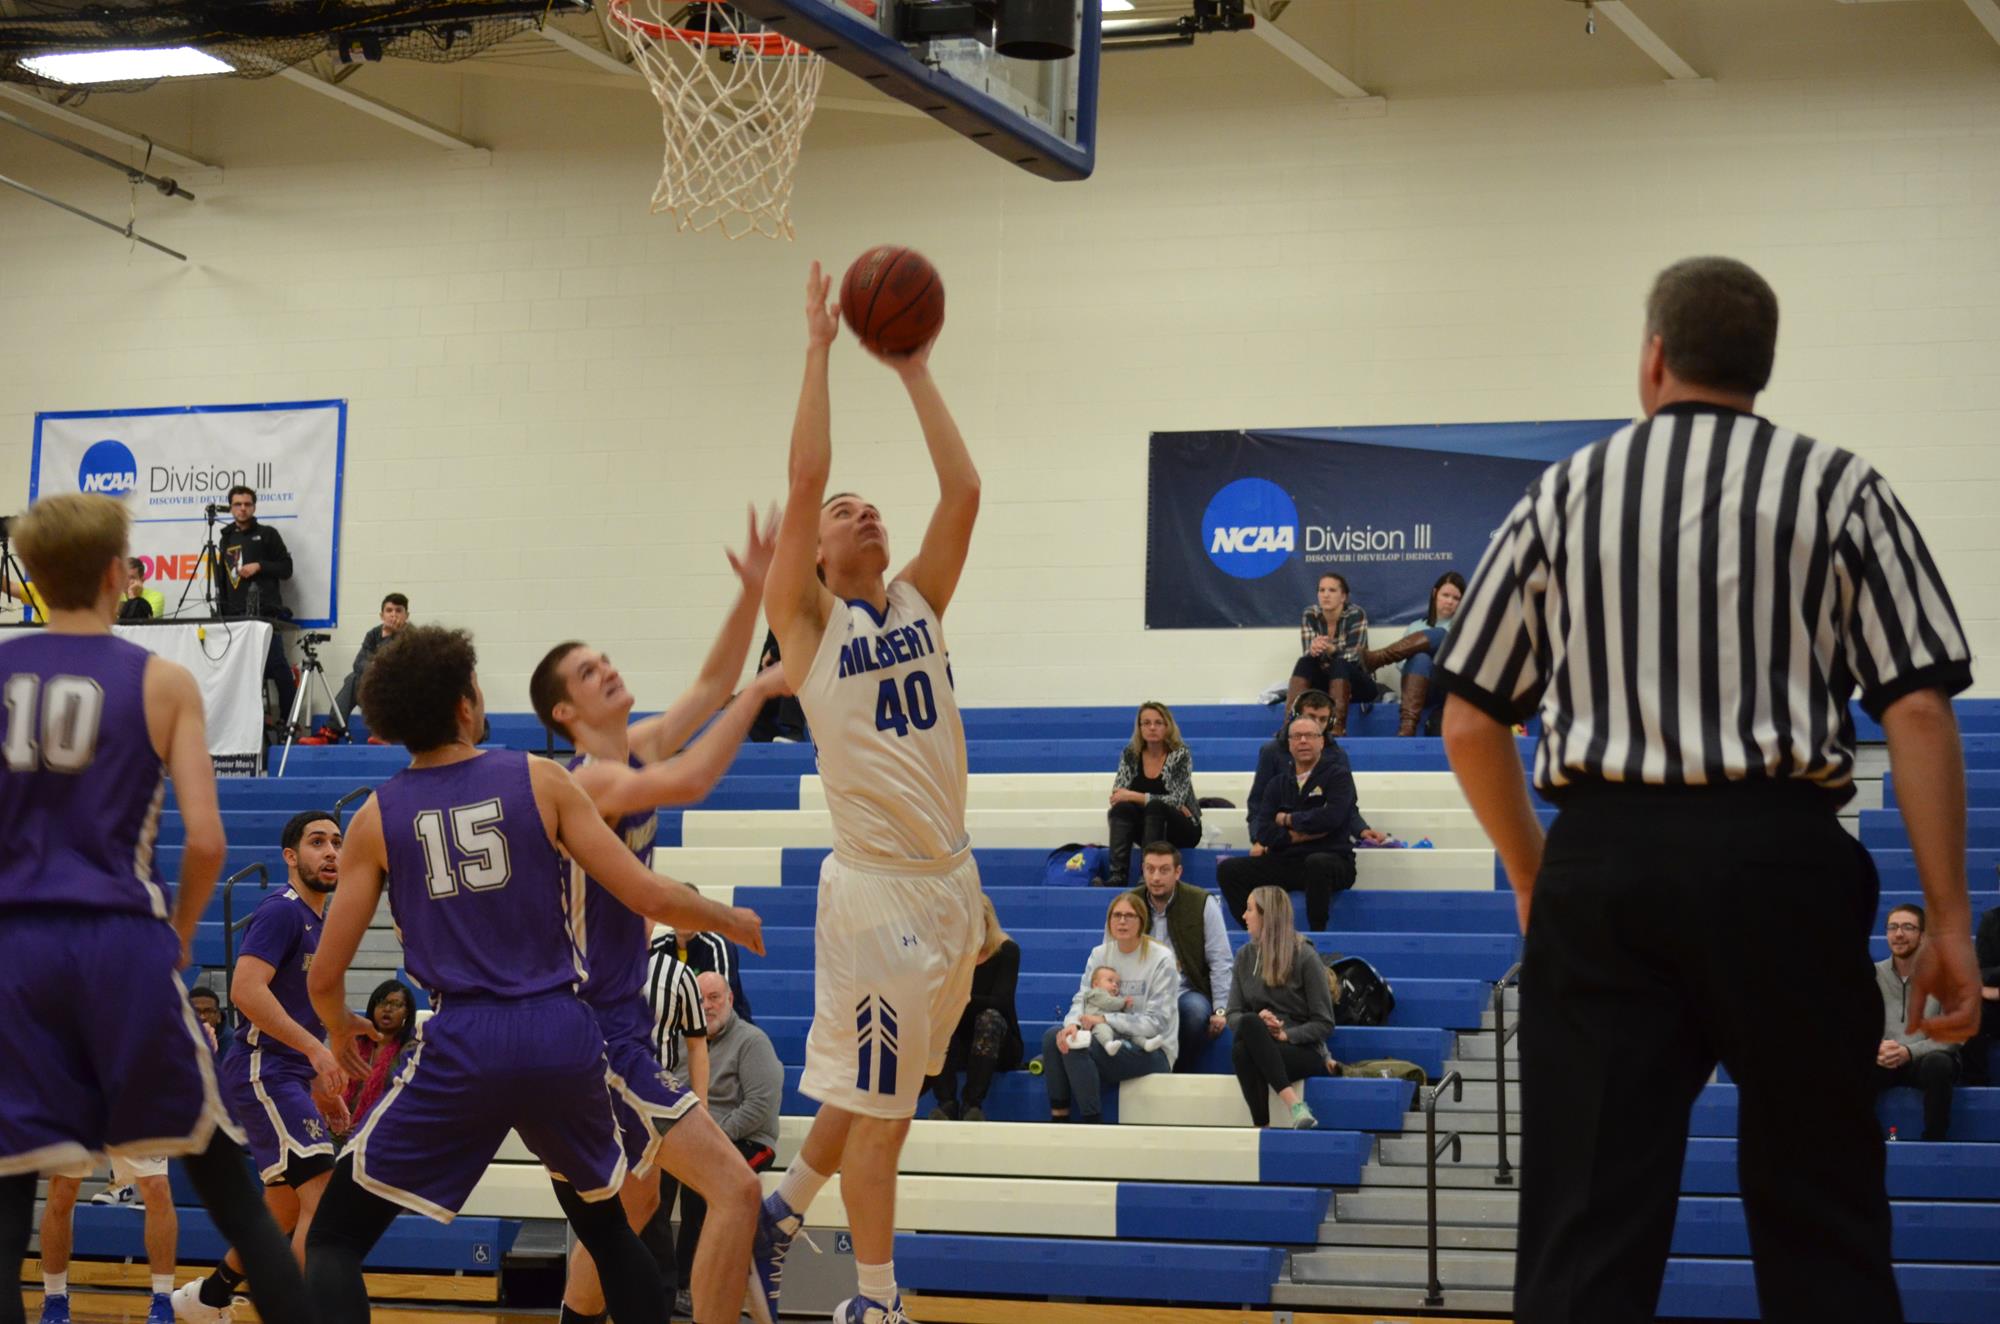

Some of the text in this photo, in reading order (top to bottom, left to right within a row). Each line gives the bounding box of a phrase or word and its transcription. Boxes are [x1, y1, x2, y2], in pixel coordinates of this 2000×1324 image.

[83, 472, 136, 492] NCAA
[150, 462, 272, 493] Division III
[149, 496, 194, 505] DISCOVER
[1211, 526, 1295, 553] NCAA
[1305, 524, 1431, 551] Division III
[1305, 552, 1453, 562] DISCOVER DEVELOP DEDICATE
[875, 670, 937, 738] 40
[3, 672, 105, 775] 10
[213, 760, 255, 769] Senior Men's
[413, 797, 511, 900] 15
